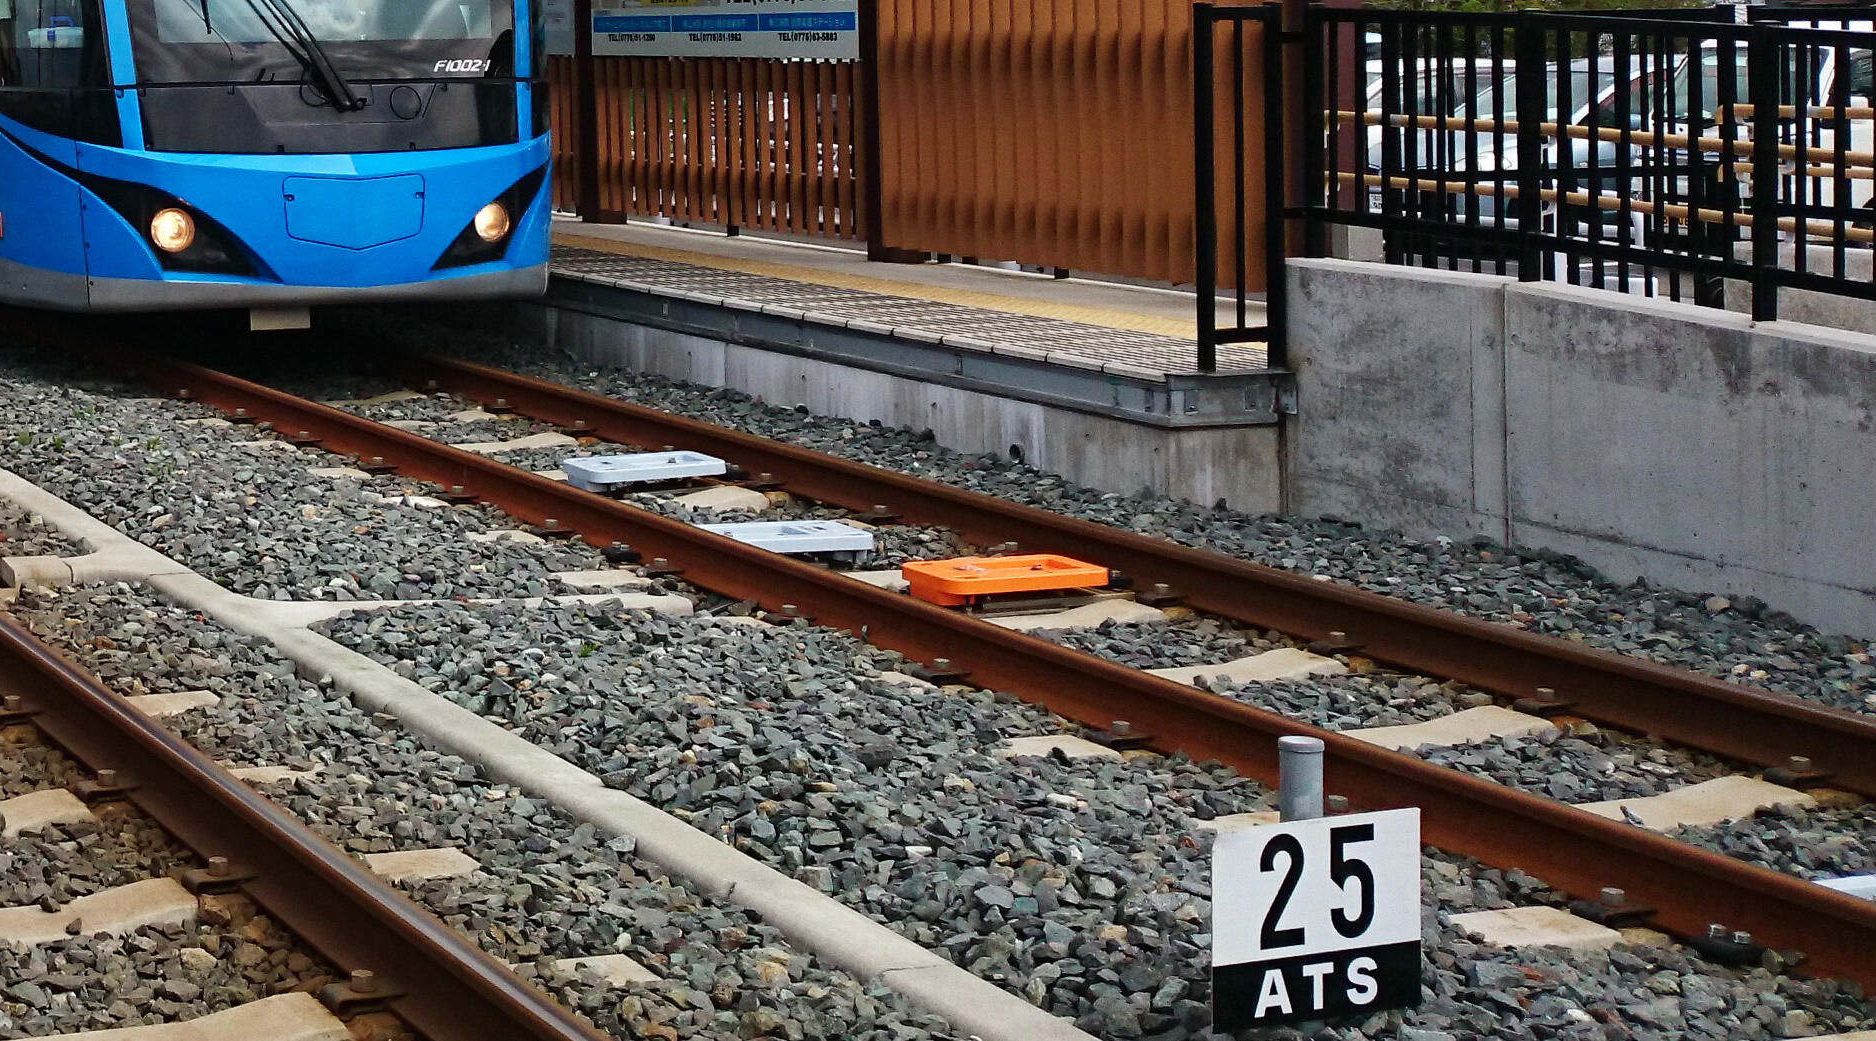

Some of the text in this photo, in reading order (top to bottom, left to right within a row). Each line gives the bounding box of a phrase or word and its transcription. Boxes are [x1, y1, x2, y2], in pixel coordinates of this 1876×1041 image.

[433, 59, 492, 73] F1002-1
[1259, 823, 1376, 951] 25
[1254, 956, 1379, 1019] ATS
